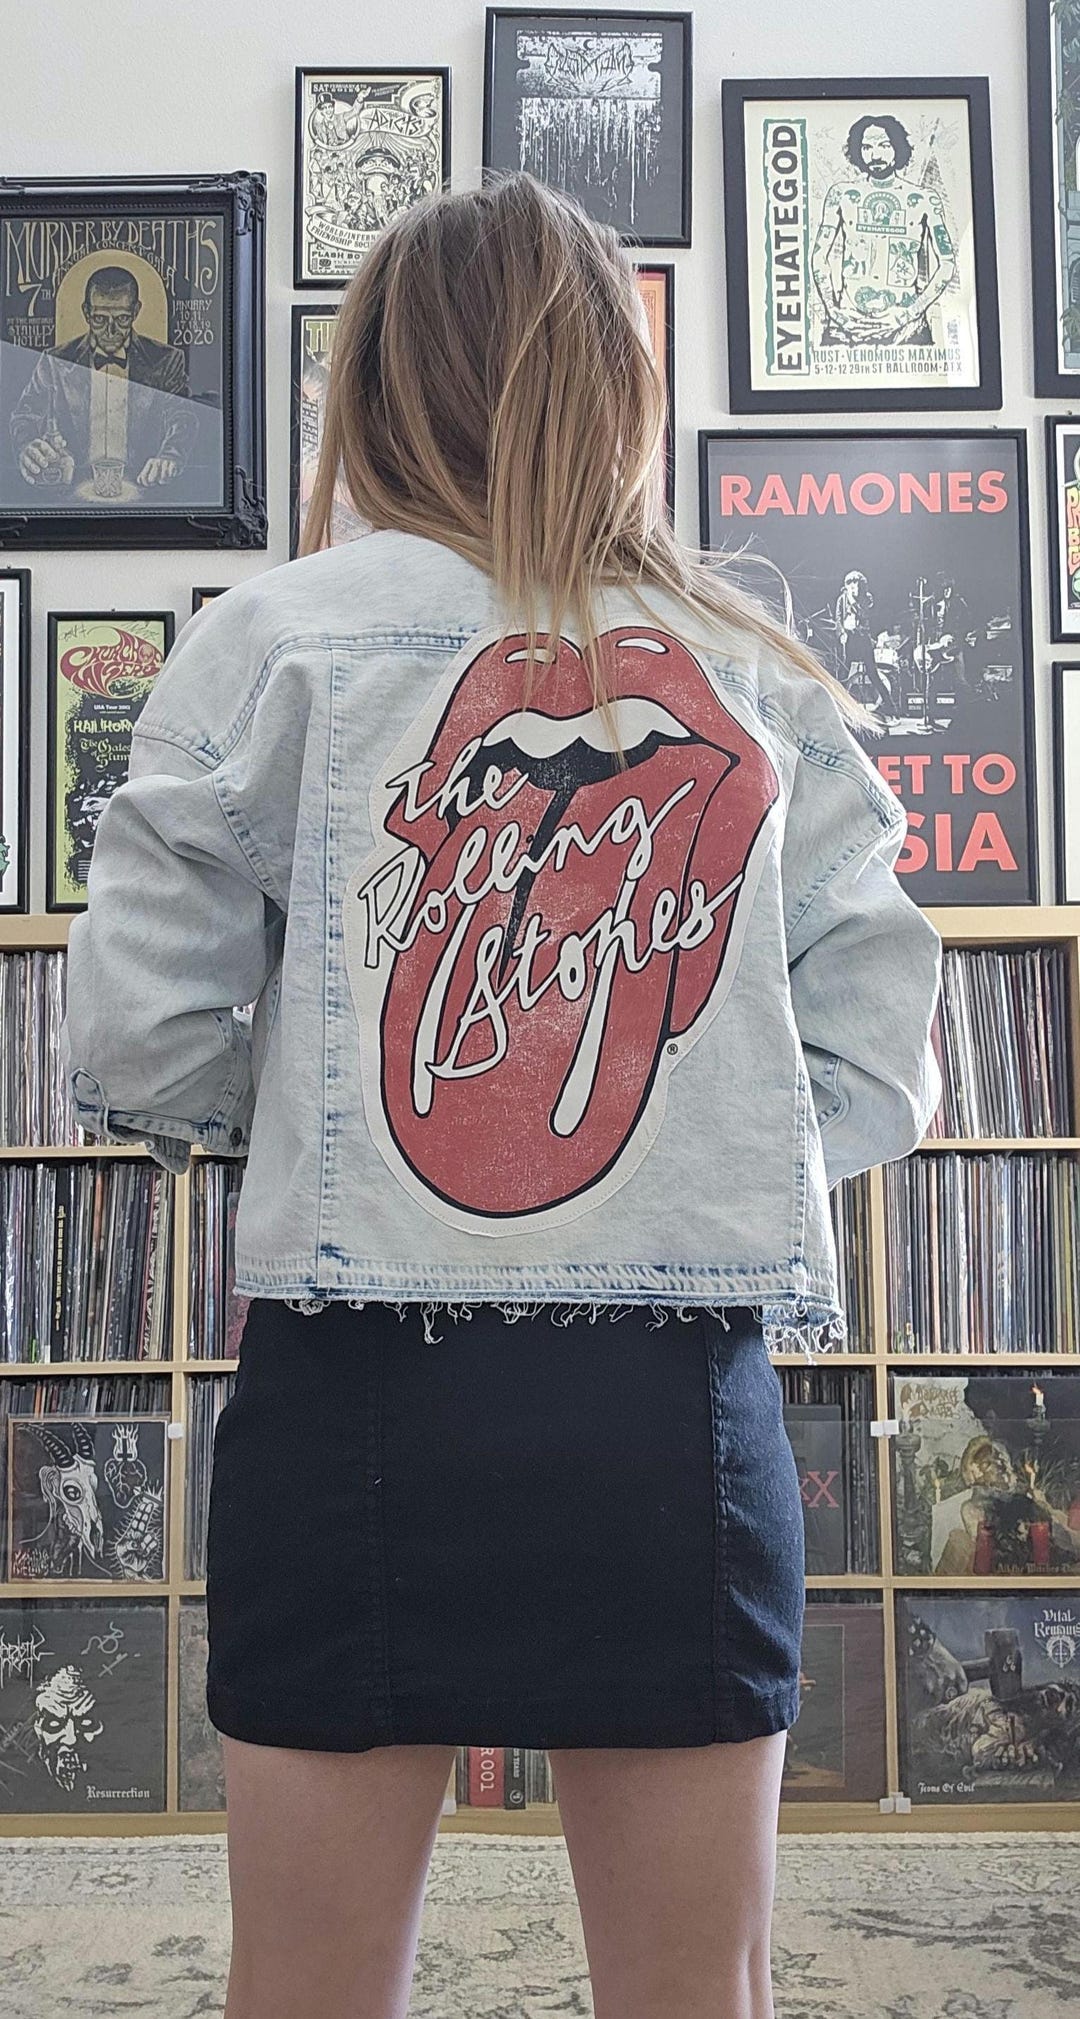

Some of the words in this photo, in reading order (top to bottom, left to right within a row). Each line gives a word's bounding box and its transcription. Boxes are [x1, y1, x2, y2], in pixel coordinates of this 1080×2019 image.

[313, 84, 329, 92] SAT
[362, 108, 421, 135] ADICTS
[311, 226, 352, 248] FRIENDSHIP
[857, 225, 905, 234] EYEHATEGOD
[772, 124, 802, 371] EYEHATEGOD
[5, 220, 95, 298] MURDER
[101, 220, 125, 242] BY
[128, 220, 219, 296] DEATH'S
[172, 299, 212, 317] JANUARY
[8, 325, 55, 336] STANLEY
[173, 329, 214, 345] 2020
[13, 335, 49, 348] HOTEL
[908, 349, 961, 362] MAXIMUS
[872, 363, 882, 374] ST
[720, 470, 1008, 516] RAMONES
[80, 738, 98, 752] The
[944, 754, 1017, 795] TO
[358, 779, 696, 968] Rolling
[424, 873, 742, 1080] Stones
[1042, 1609, 1076, 1622] Vital
[1033, 1621, 1080, 1637] Remains
[480, 1759, 495, 1792] 001
[86, 1785, 151, 1800] Resurrection
[917, 1782, 940, 1794] Icons
[942, 1782, 955, 1793] Of
[957, 1781, 975, 1793] Evil
